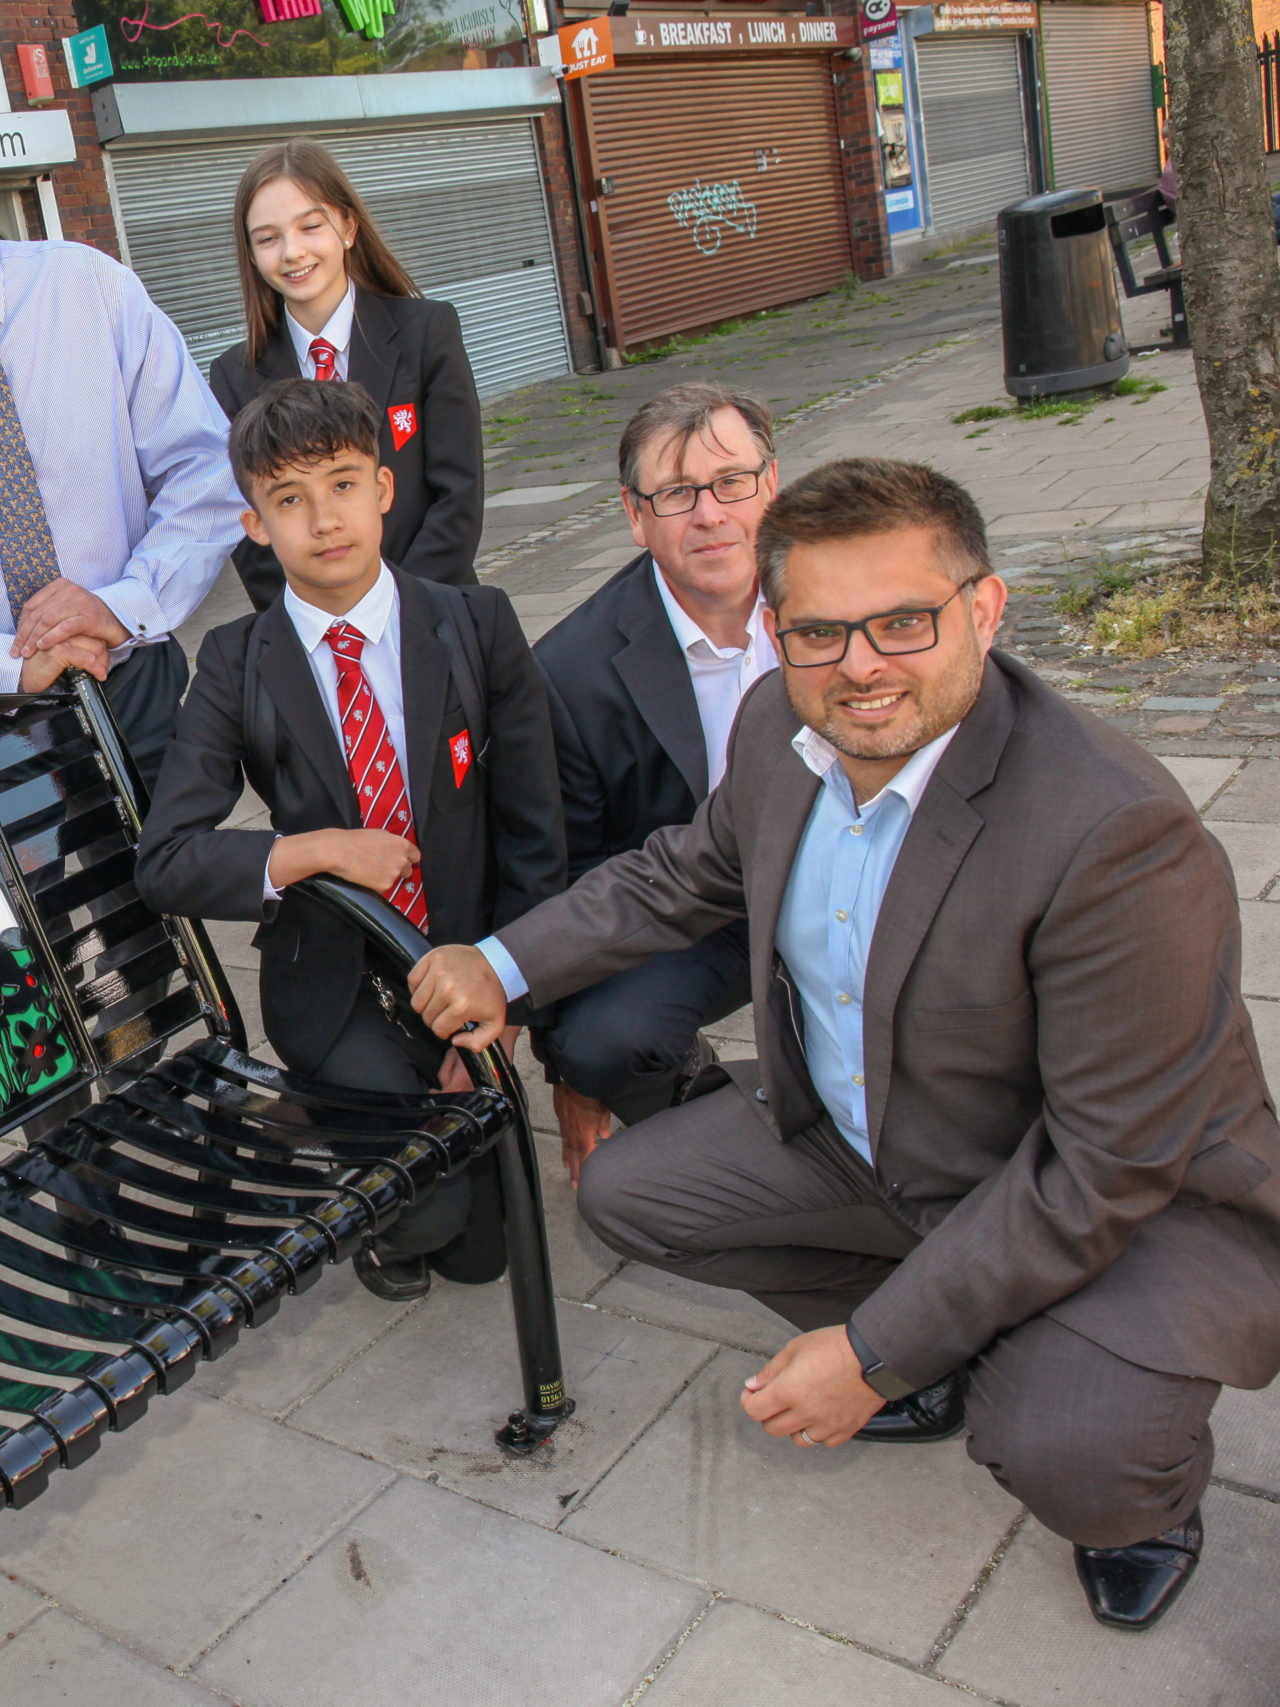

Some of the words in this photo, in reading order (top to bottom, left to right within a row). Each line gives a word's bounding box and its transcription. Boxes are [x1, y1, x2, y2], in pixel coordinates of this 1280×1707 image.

[659, 22, 732, 46] BREAKFAST
[747, 21, 787, 43] LUNCH
[798, 21, 838, 43] DINNER
[863, 19, 896, 36] payzone
[568, 59, 590, 74] JUST
[590, 54, 608, 67] EAT
